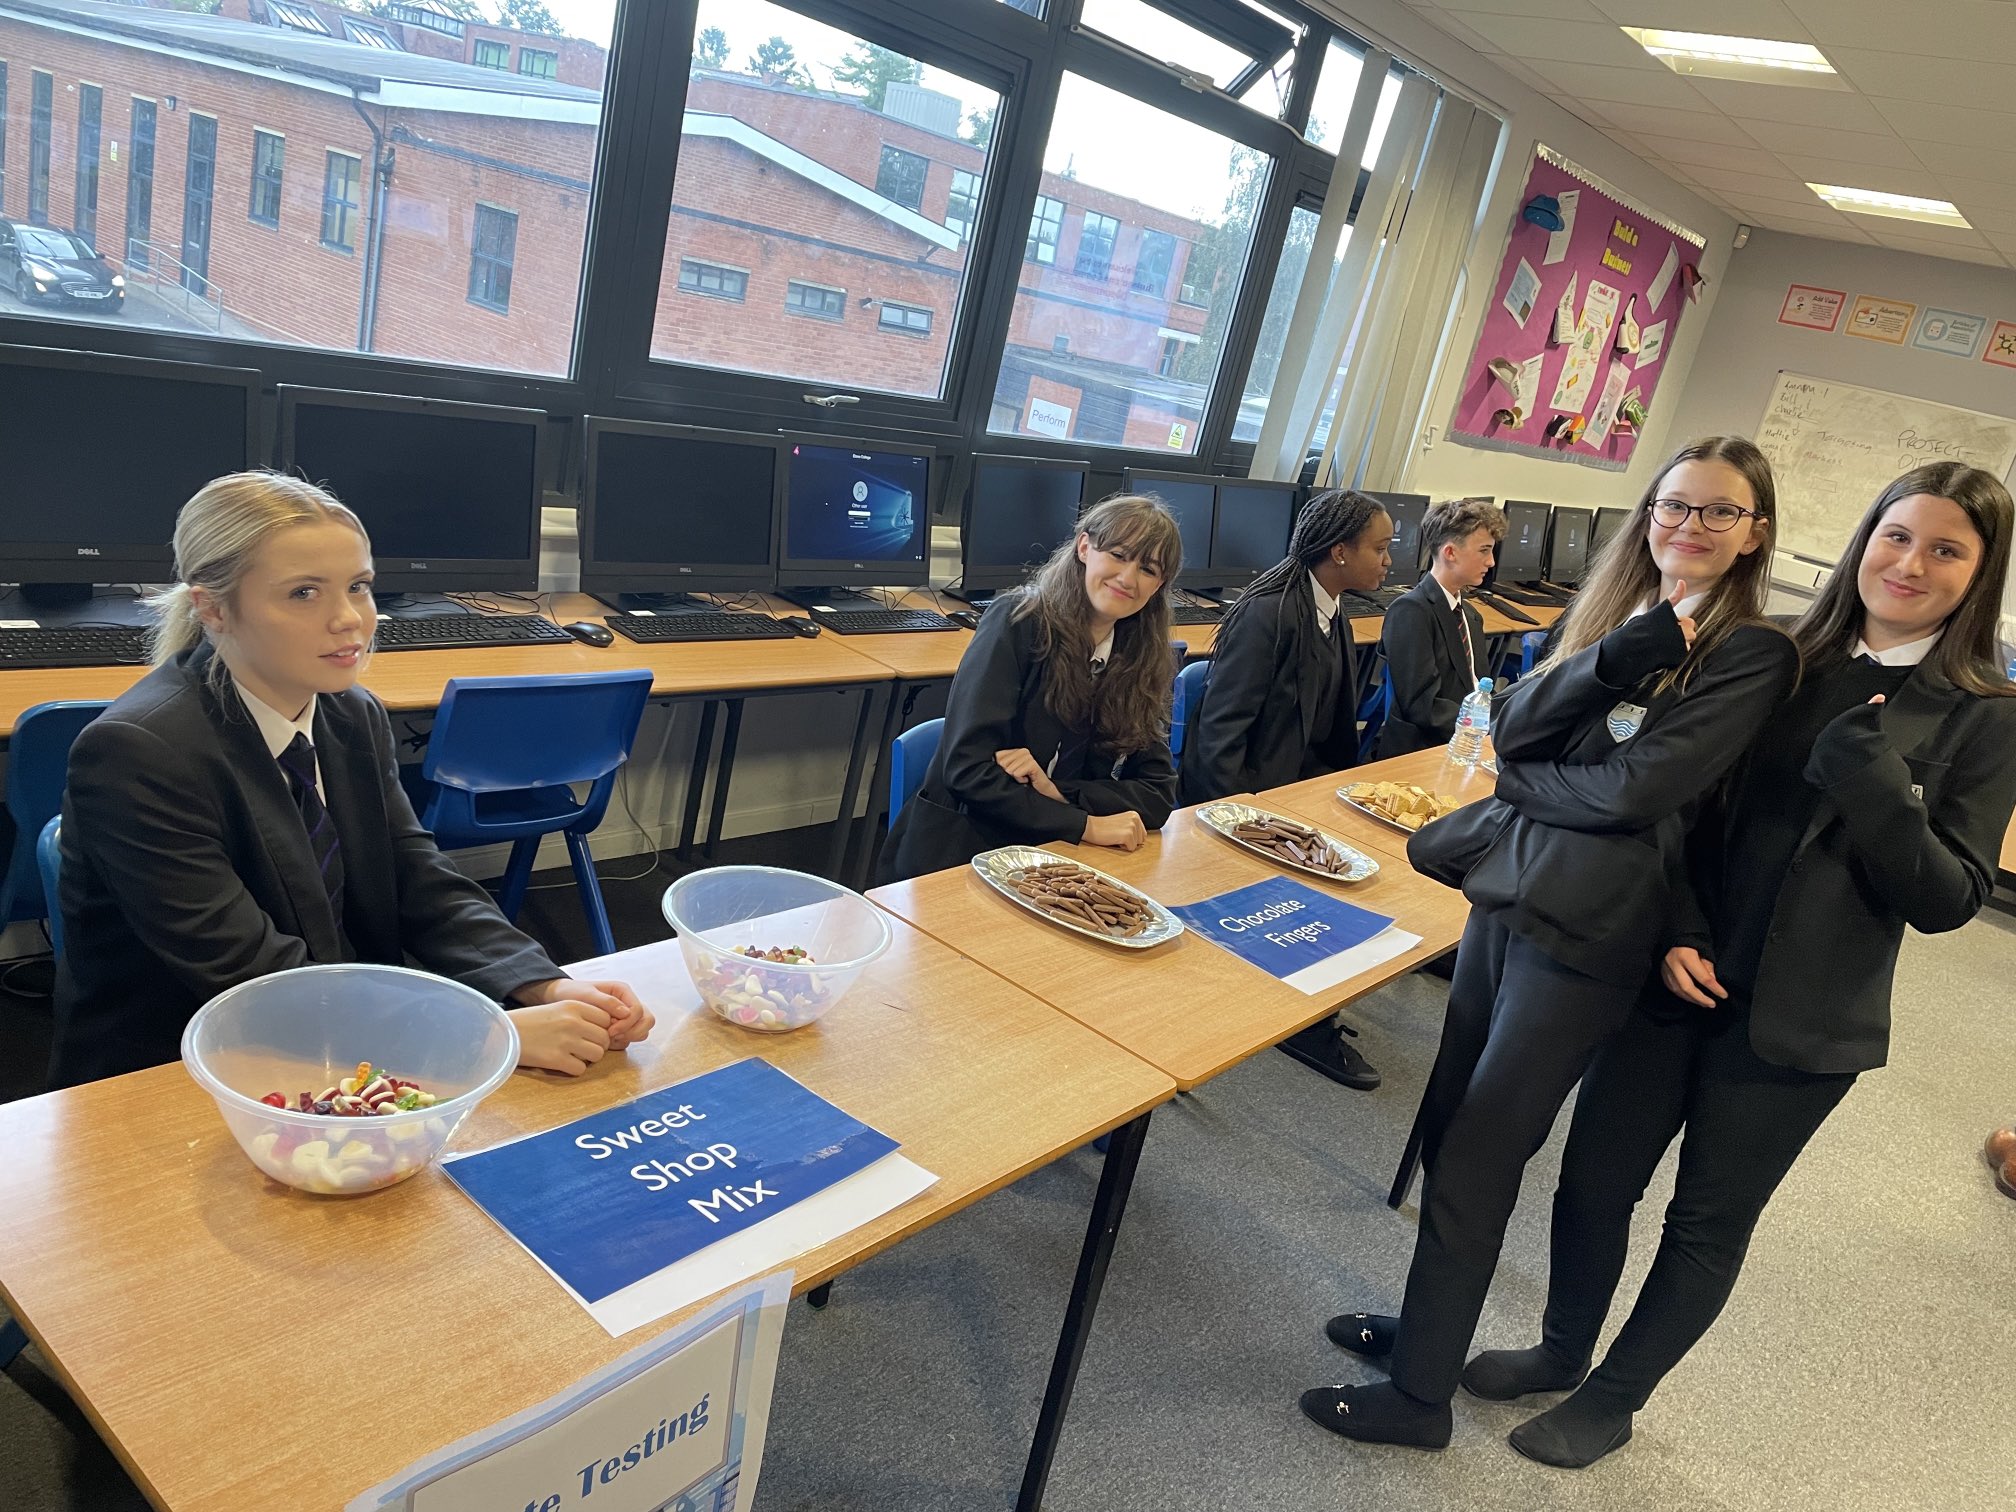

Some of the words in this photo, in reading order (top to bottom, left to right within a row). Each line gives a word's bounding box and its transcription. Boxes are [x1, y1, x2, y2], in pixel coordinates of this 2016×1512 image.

[1031, 409, 1067, 429] Perform
[78, 548, 100, 556] DELL
[1219, 899, 1306, 932] Chocolate
[1264, 920, 1331, 948] Fingers
[574, 1104, 707, 1160] Sweet
[630, 1143, 738, 1191] Shop
[687, 1179, 780, 1223] Mix
[576, 1392, 710, 1500] Testing
